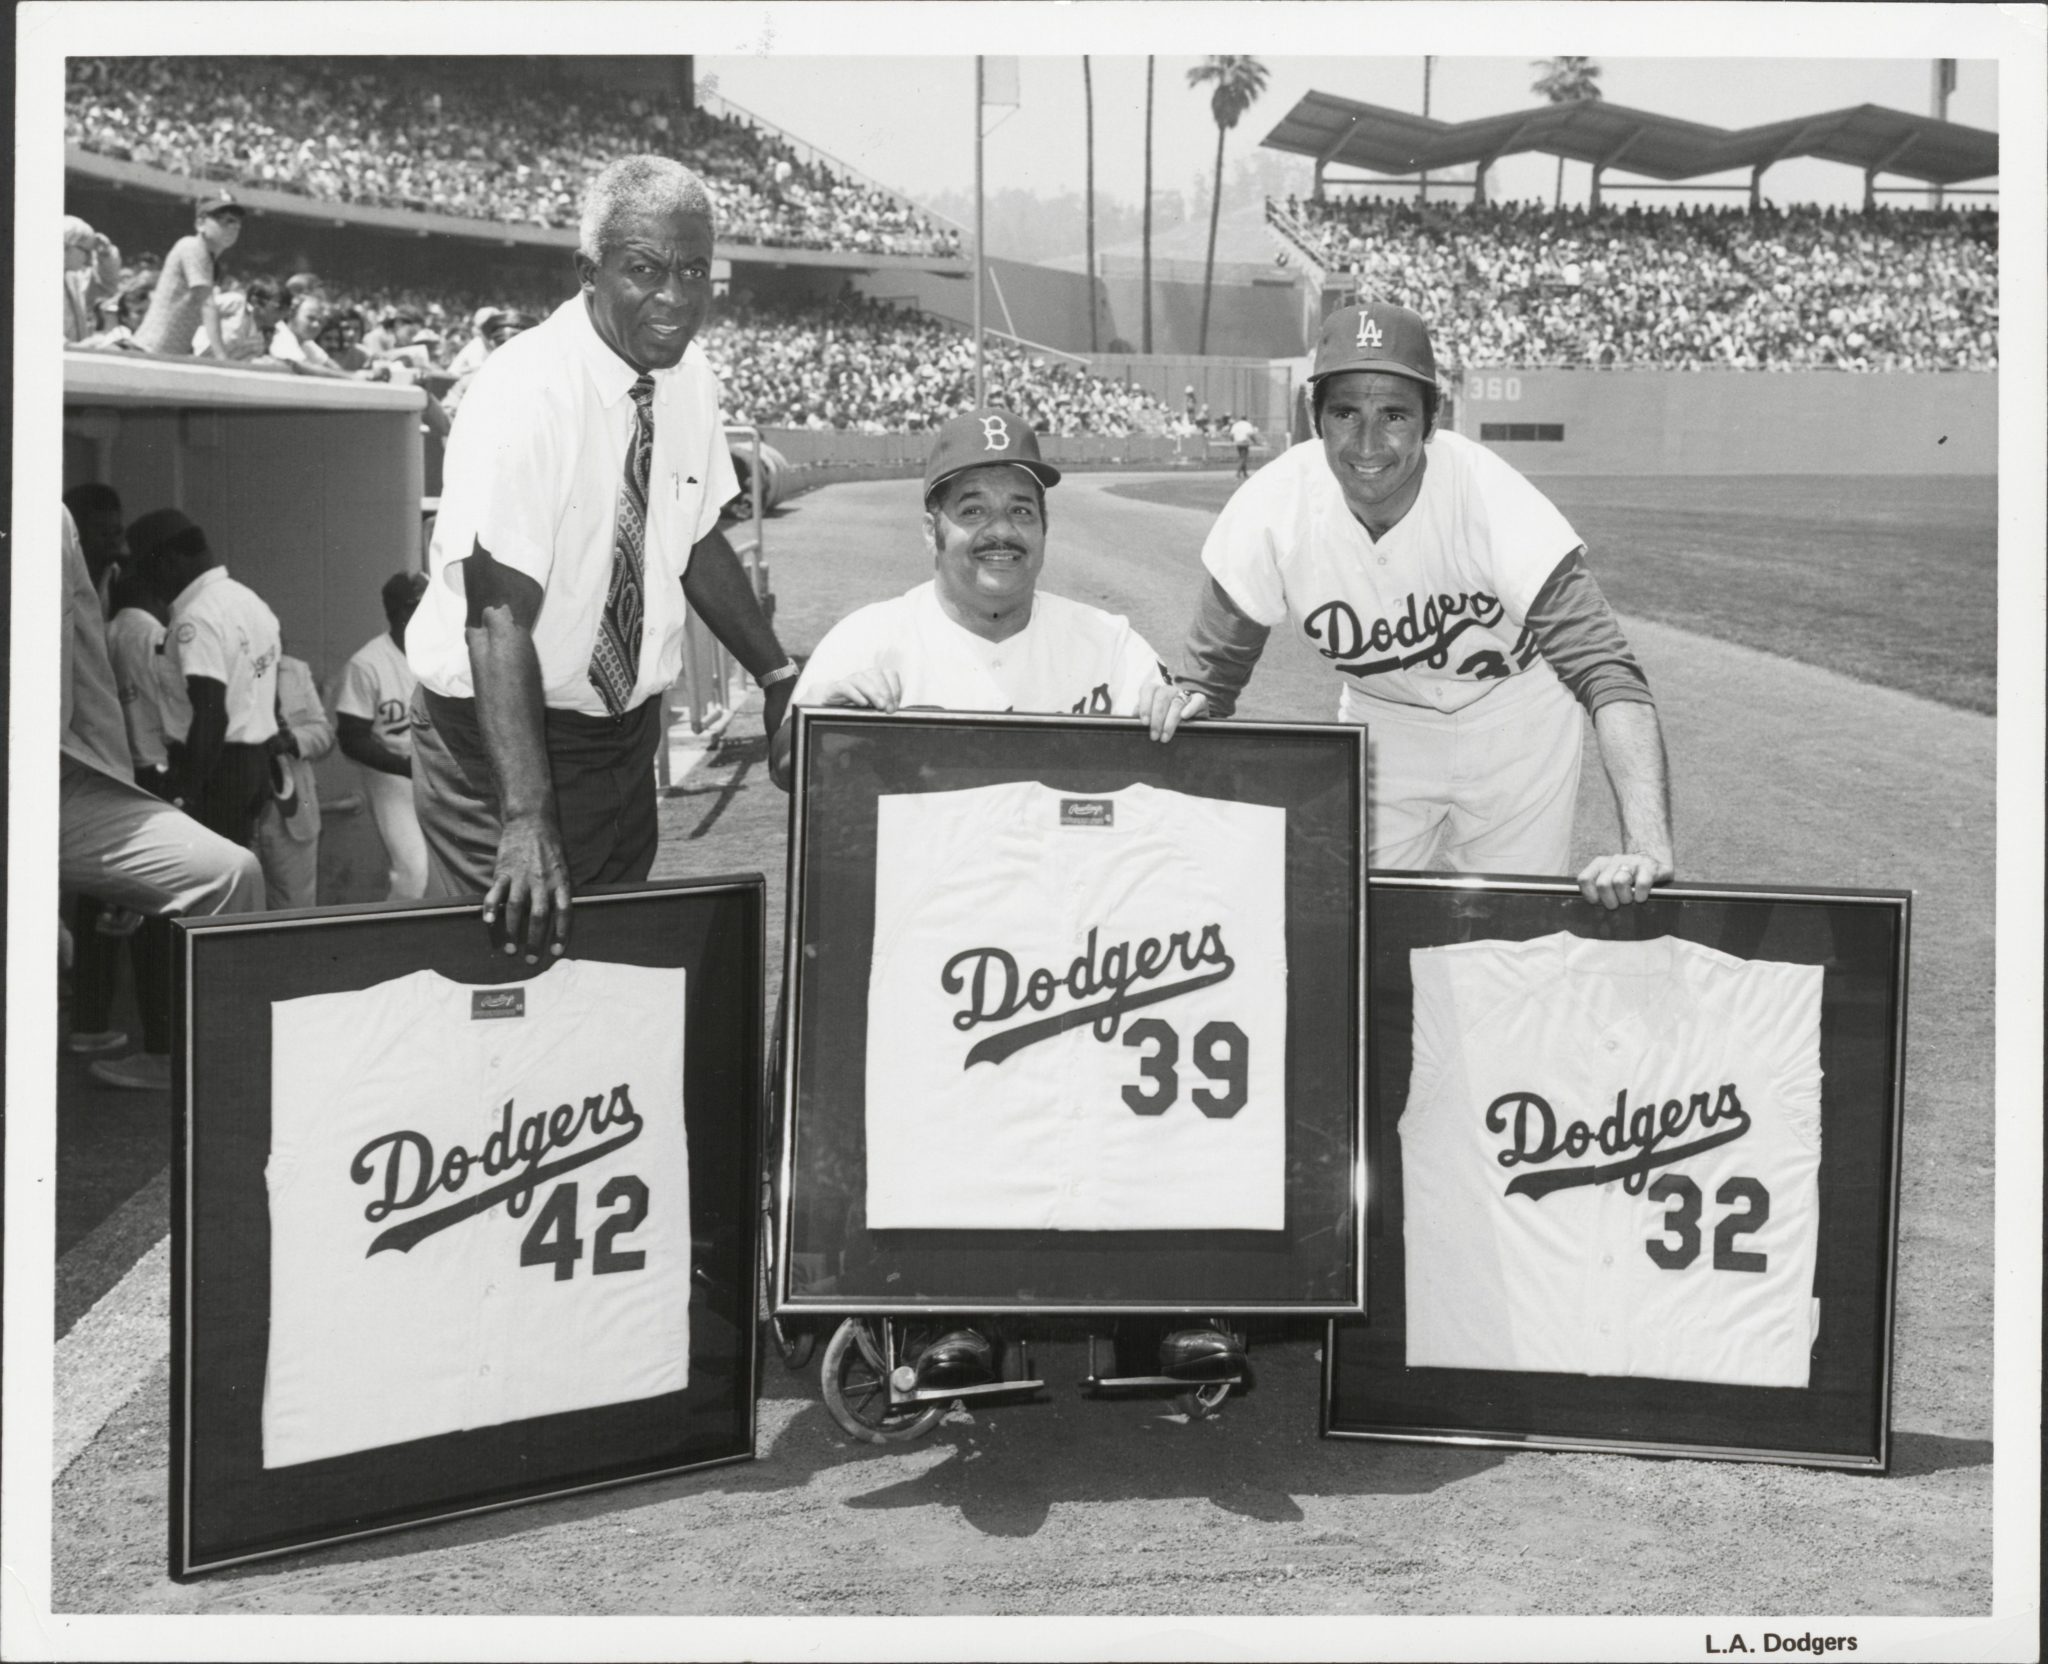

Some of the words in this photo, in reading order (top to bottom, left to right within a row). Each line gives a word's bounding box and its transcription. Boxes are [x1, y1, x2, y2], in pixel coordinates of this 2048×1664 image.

[1356, 311, 1383, 348] LA
[979, 415, 1011, 451] B
[1470, 377, 1521, 400] 360
[941, 923, 1235, 1071] Dodgers
[1121, 1018, 1249, 1119] 39
[350, 1083, 644, 1259] Dodgers
[1486, 1083, 1751, 1201] Dodgers
[520, 1174, 650, 1282] 42
[1646, 1173, 1770, 1273] 32
